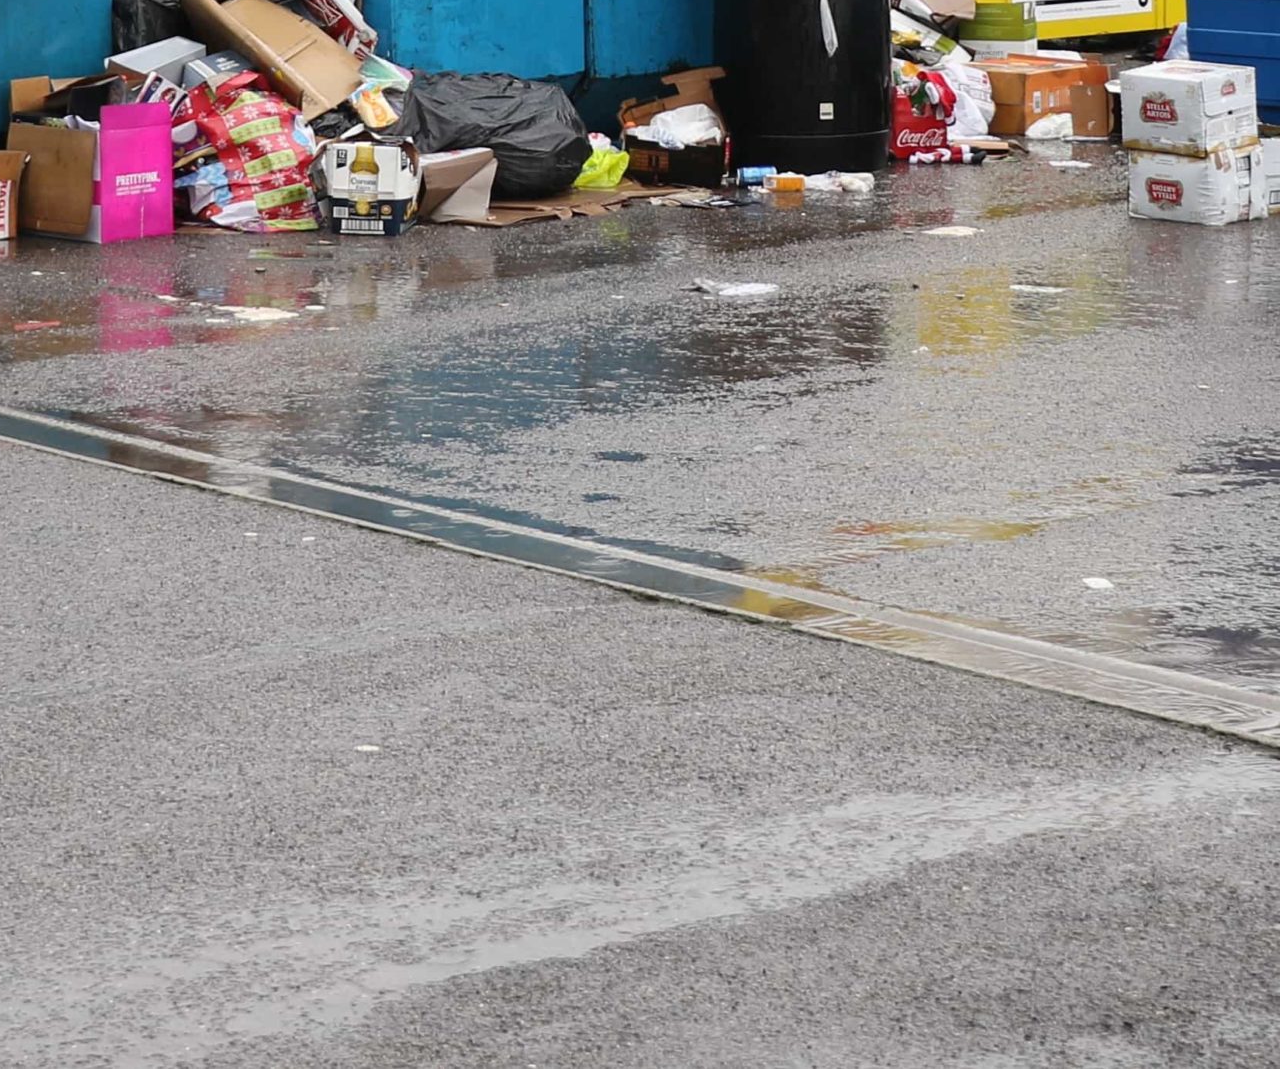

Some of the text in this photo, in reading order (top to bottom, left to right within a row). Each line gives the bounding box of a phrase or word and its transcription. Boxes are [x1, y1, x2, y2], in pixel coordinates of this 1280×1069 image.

[1146, 102, 1169, 111] STELLA
[1146, 110, 1171, 118] ARTOIS
[1152, 191, 1177, 200] STELLA
